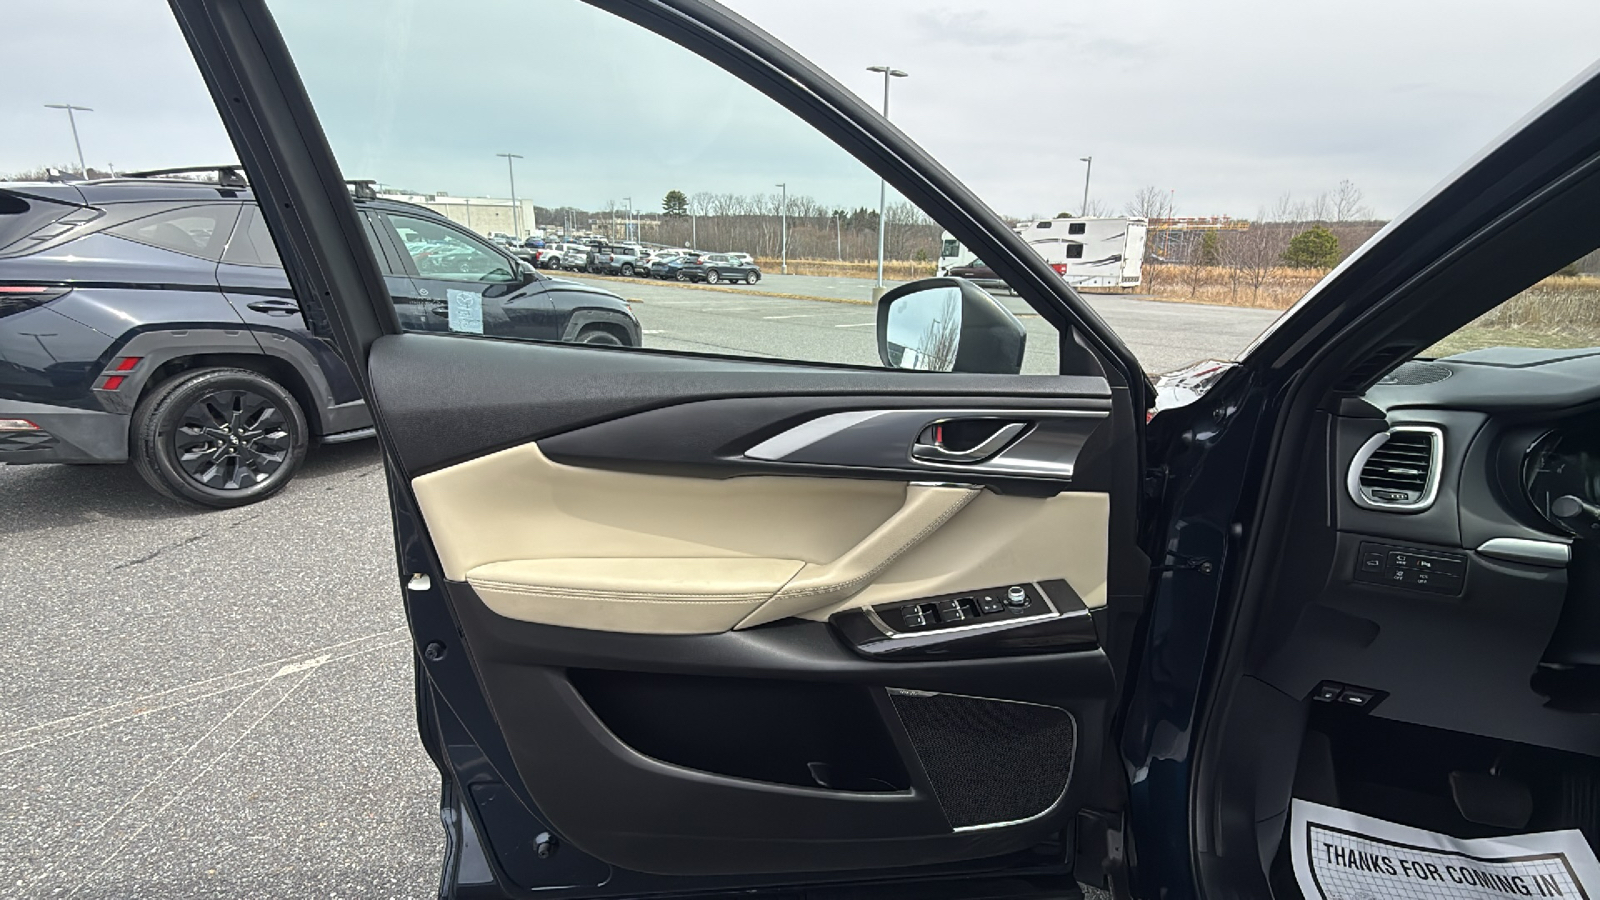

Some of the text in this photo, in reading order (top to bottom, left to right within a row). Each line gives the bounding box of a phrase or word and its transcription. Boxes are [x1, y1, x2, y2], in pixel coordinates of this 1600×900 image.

[1323, 842, 1564, 898] THANKS FOR COMING IN
